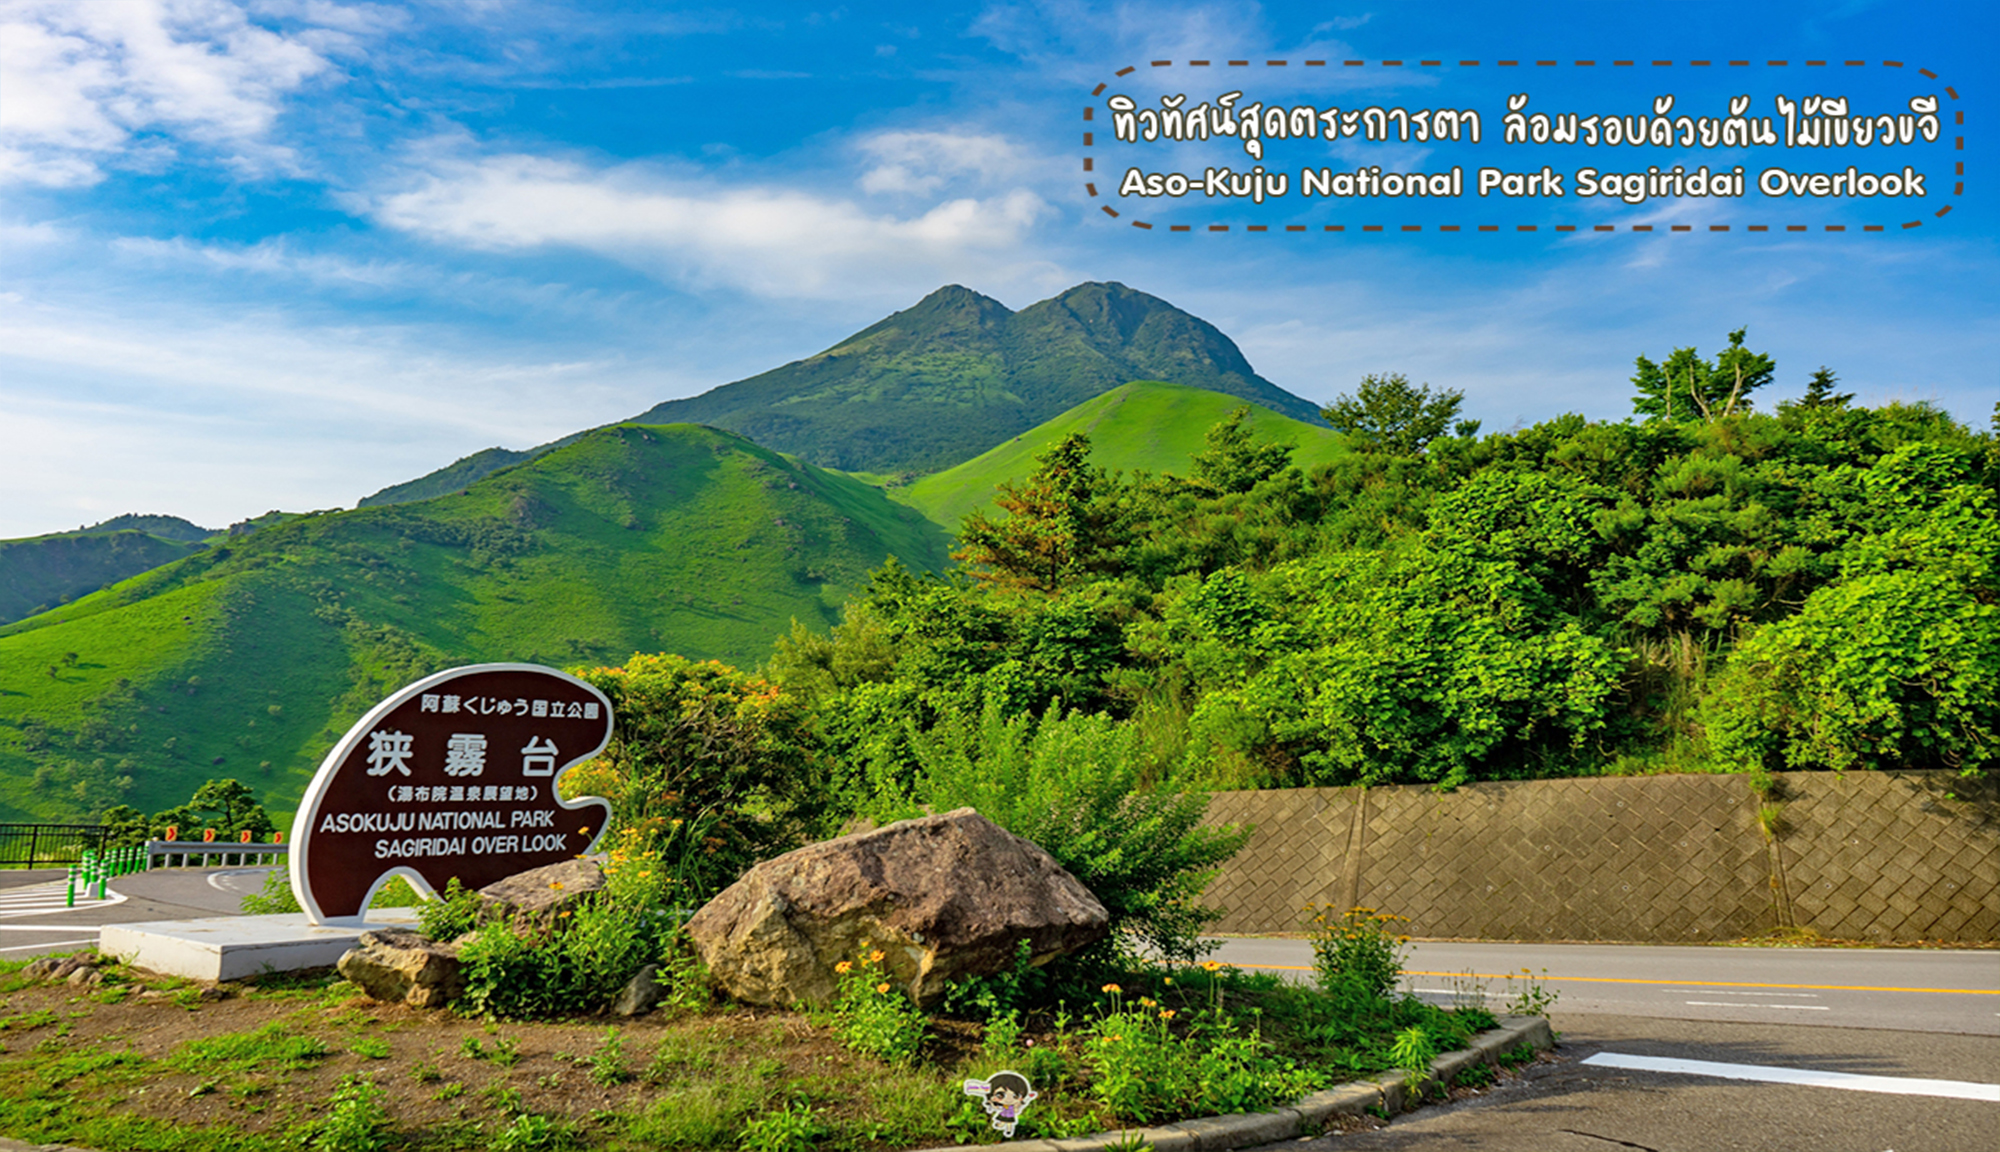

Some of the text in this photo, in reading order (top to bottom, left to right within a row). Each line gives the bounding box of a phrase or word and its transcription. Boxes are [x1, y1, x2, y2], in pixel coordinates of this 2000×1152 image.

[420, 693, 600, 720] 阿蘇くじゅう国立公園
[366, 729, 559, 777] 狭霧台
[320, 809, 556, 834] ASOKUJU NATIONAL PARK
[374, 833, 568, 859] SAGIRIDAI OVER LOOK
